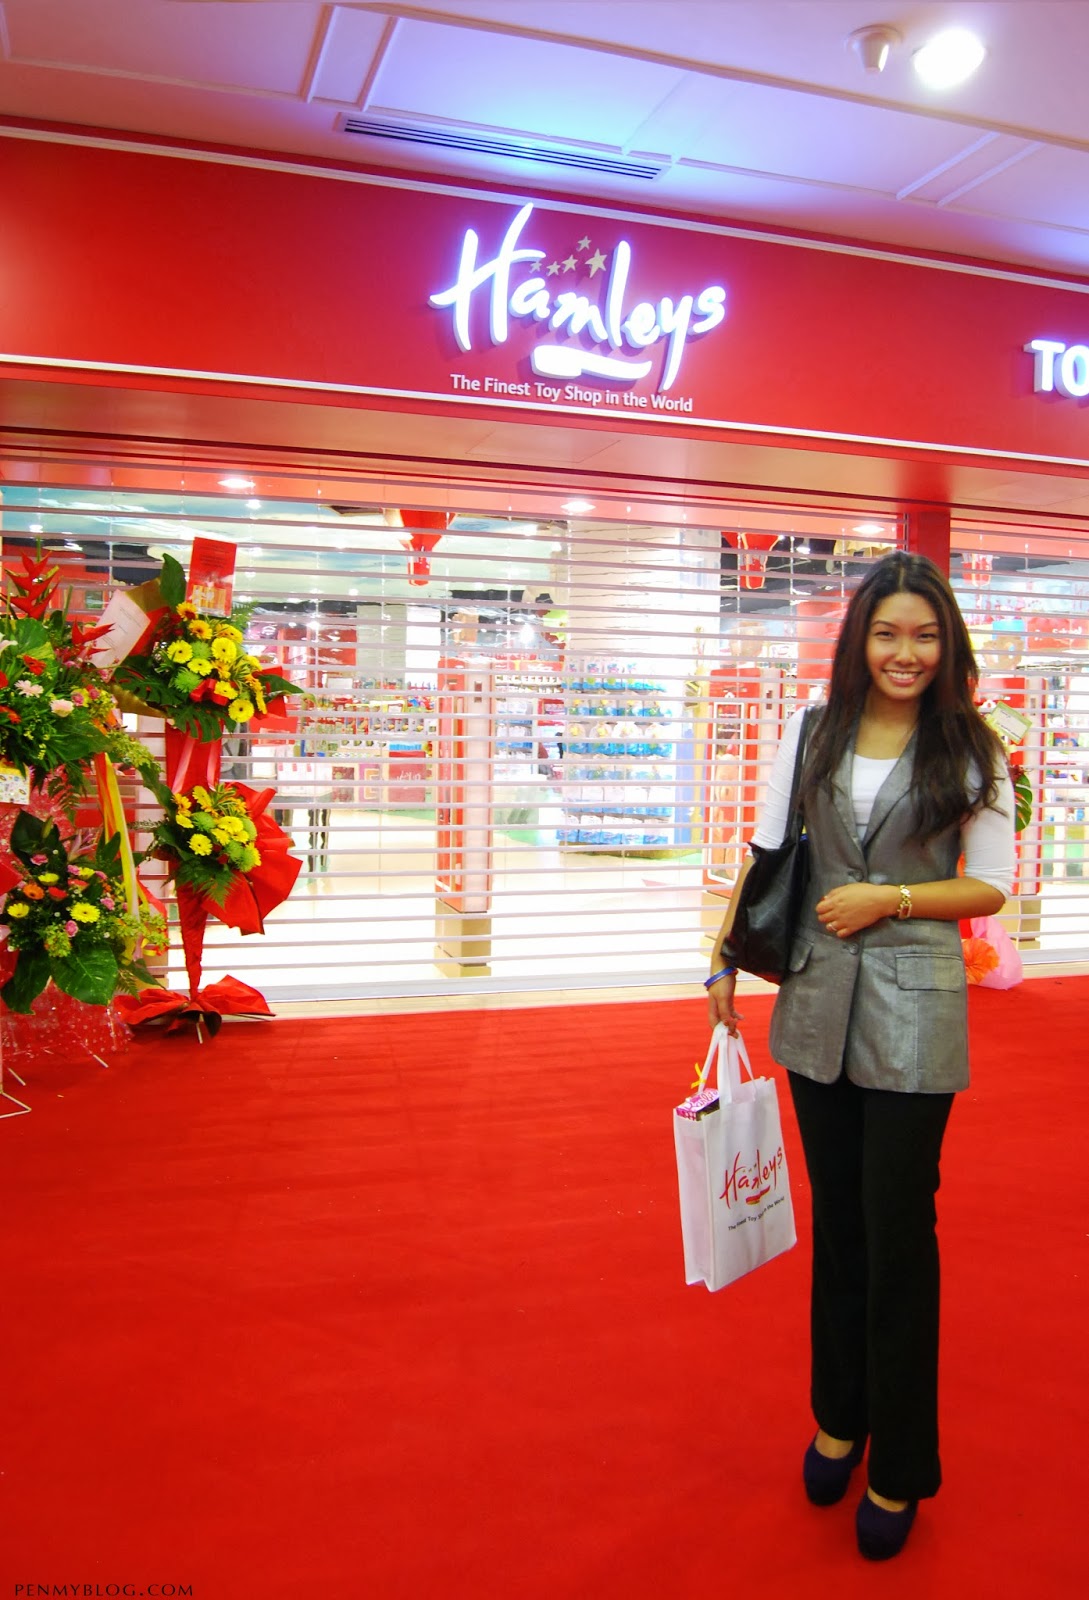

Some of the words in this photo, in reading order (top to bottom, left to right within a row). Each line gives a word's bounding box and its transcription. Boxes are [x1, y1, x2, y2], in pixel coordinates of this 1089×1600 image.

[428, 203, 727, 392] Hamleys
[450, 374, 481, 391] The
[484, 377, 531, 396] Finest
[534, 382, 561, 402] Toy
[564, 385, 602, 407] Shop
[605, 390, 620, 405] in
[623, 392, 648, 408] the
[651, 394, 693, 413] World
[1023, 339, 1089, 399] TO
